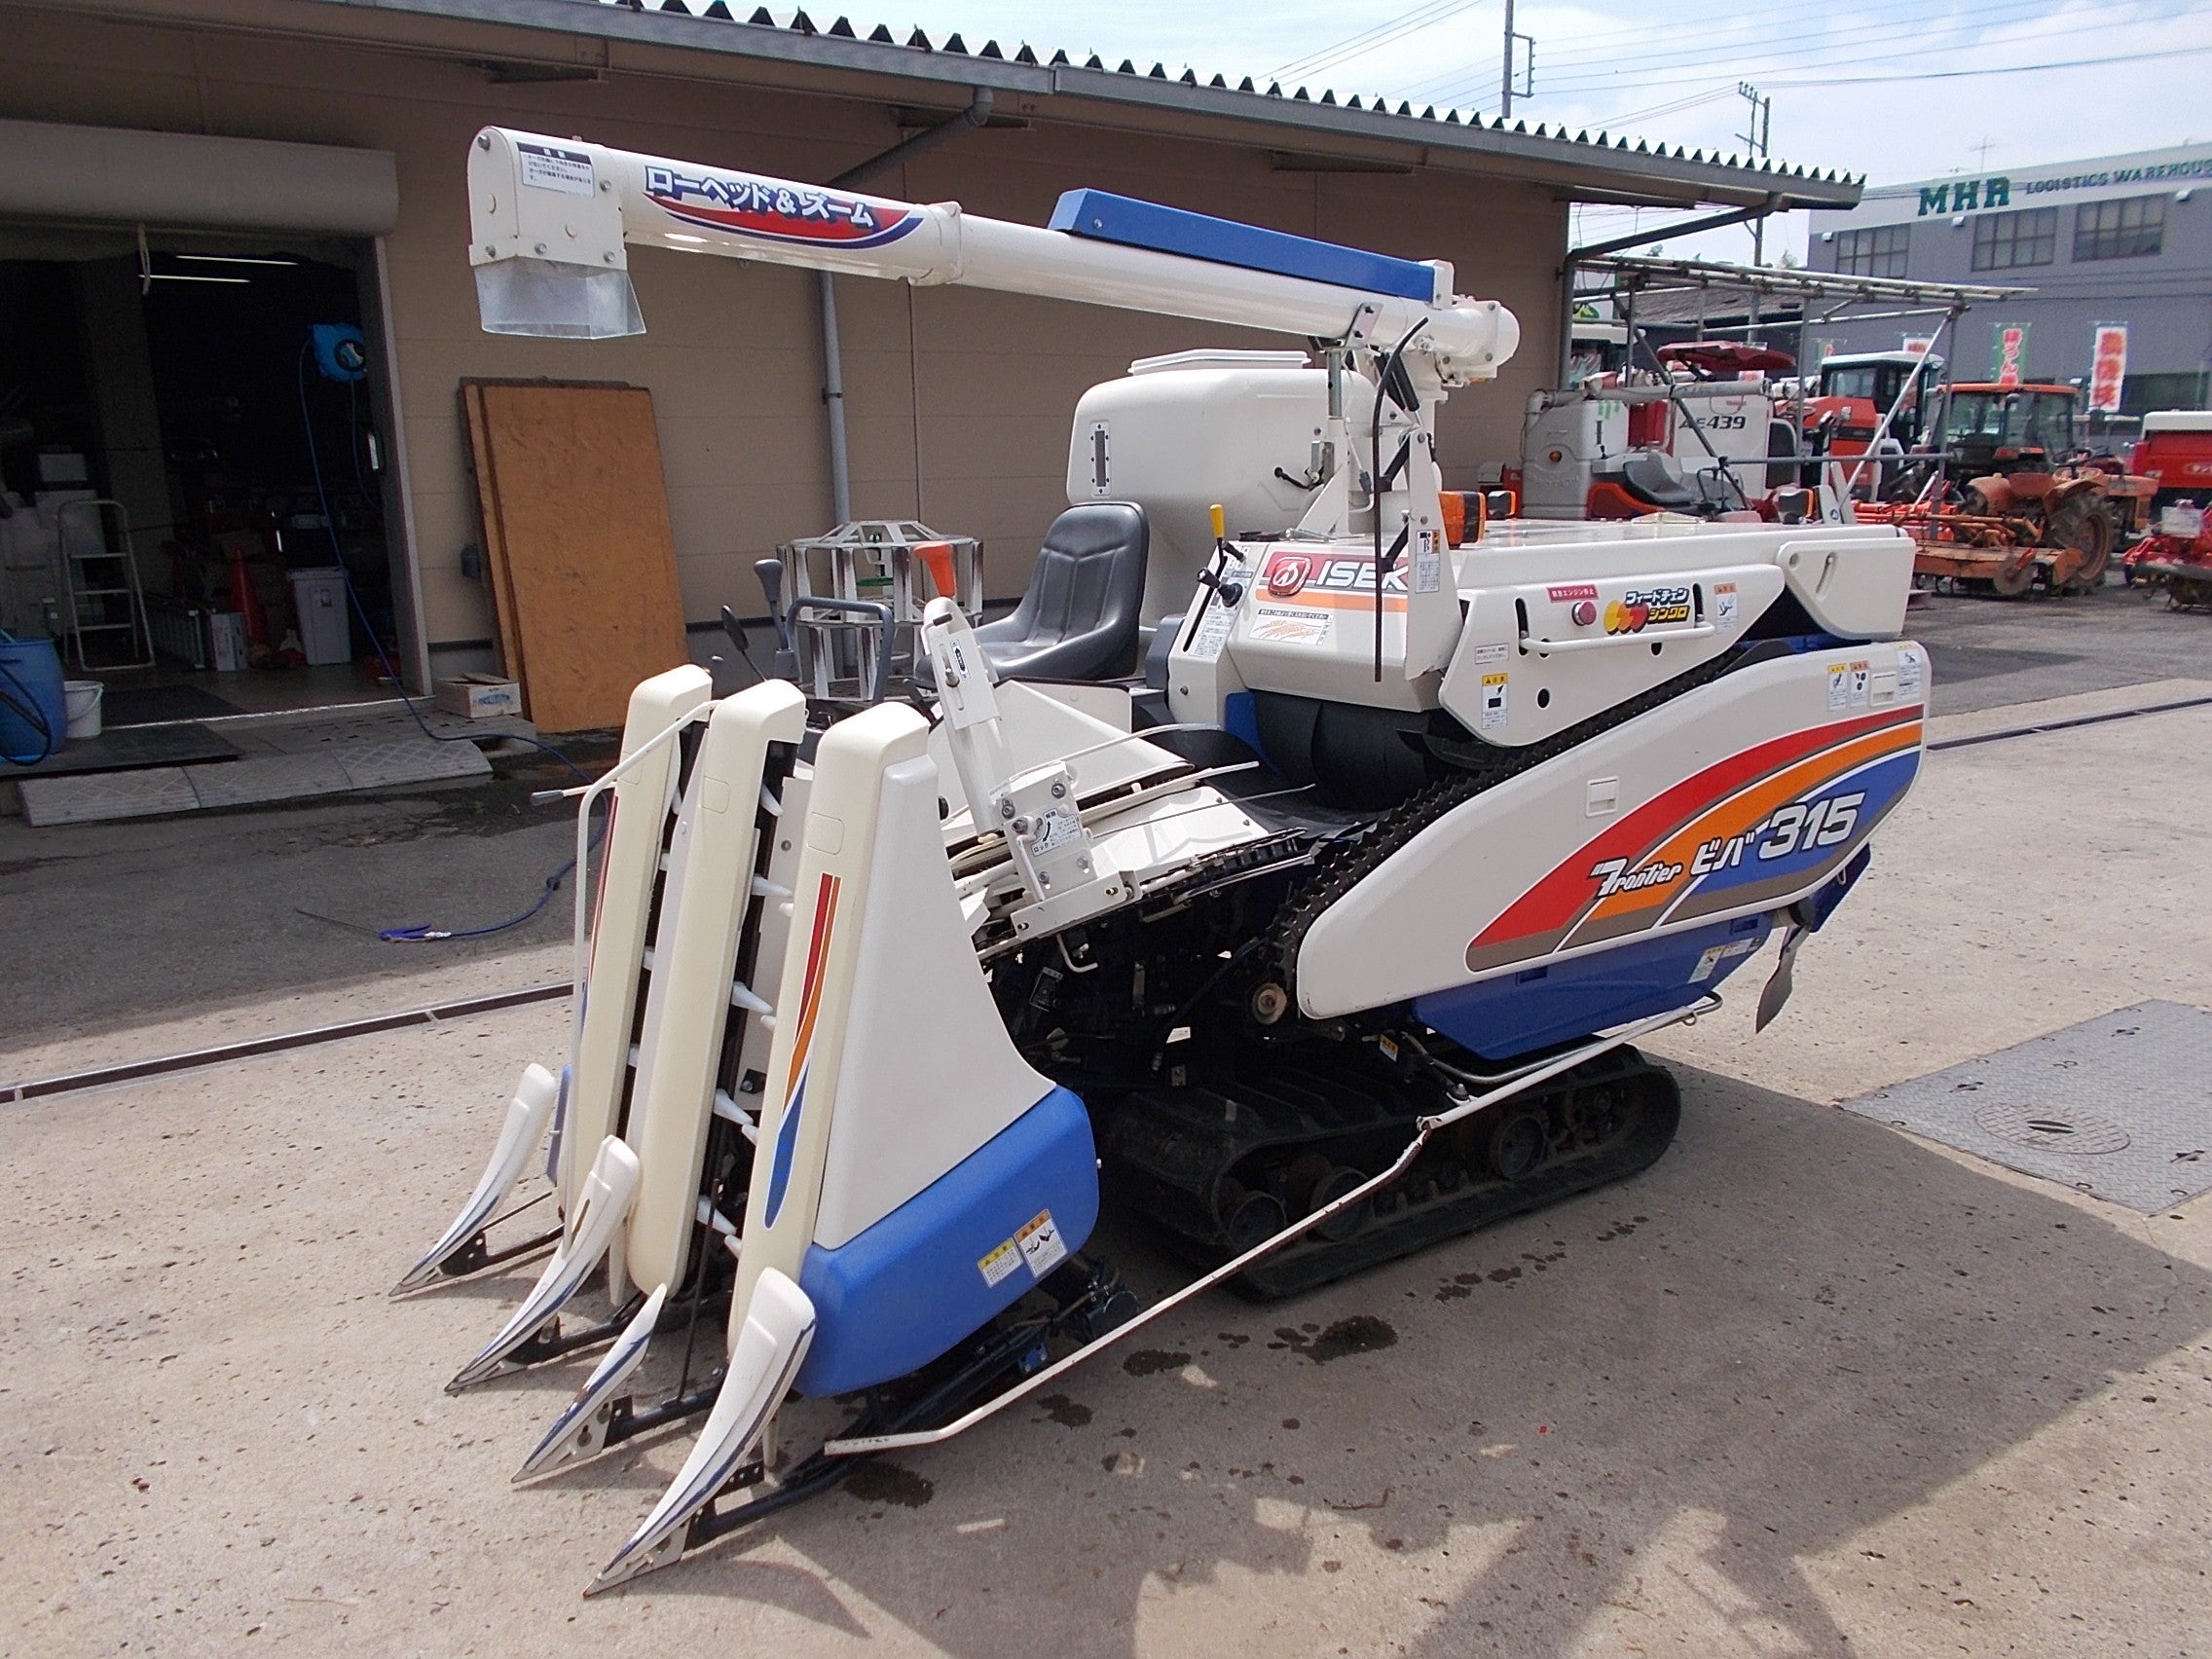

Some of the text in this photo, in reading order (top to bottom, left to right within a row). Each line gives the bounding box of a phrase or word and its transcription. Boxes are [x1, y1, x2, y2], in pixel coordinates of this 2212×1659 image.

[2026, 171, 2108, 195] LOGISTICS
[645, 166, 874, 228] ローヘッド&ズーム
[1624, 587, 1690, 608] フィードチェン
[1646, 605, 1691, 624] シンクロ
[1690, 830, 1755, 876] ビバ
[1758, 791, 1867, 861] 315
